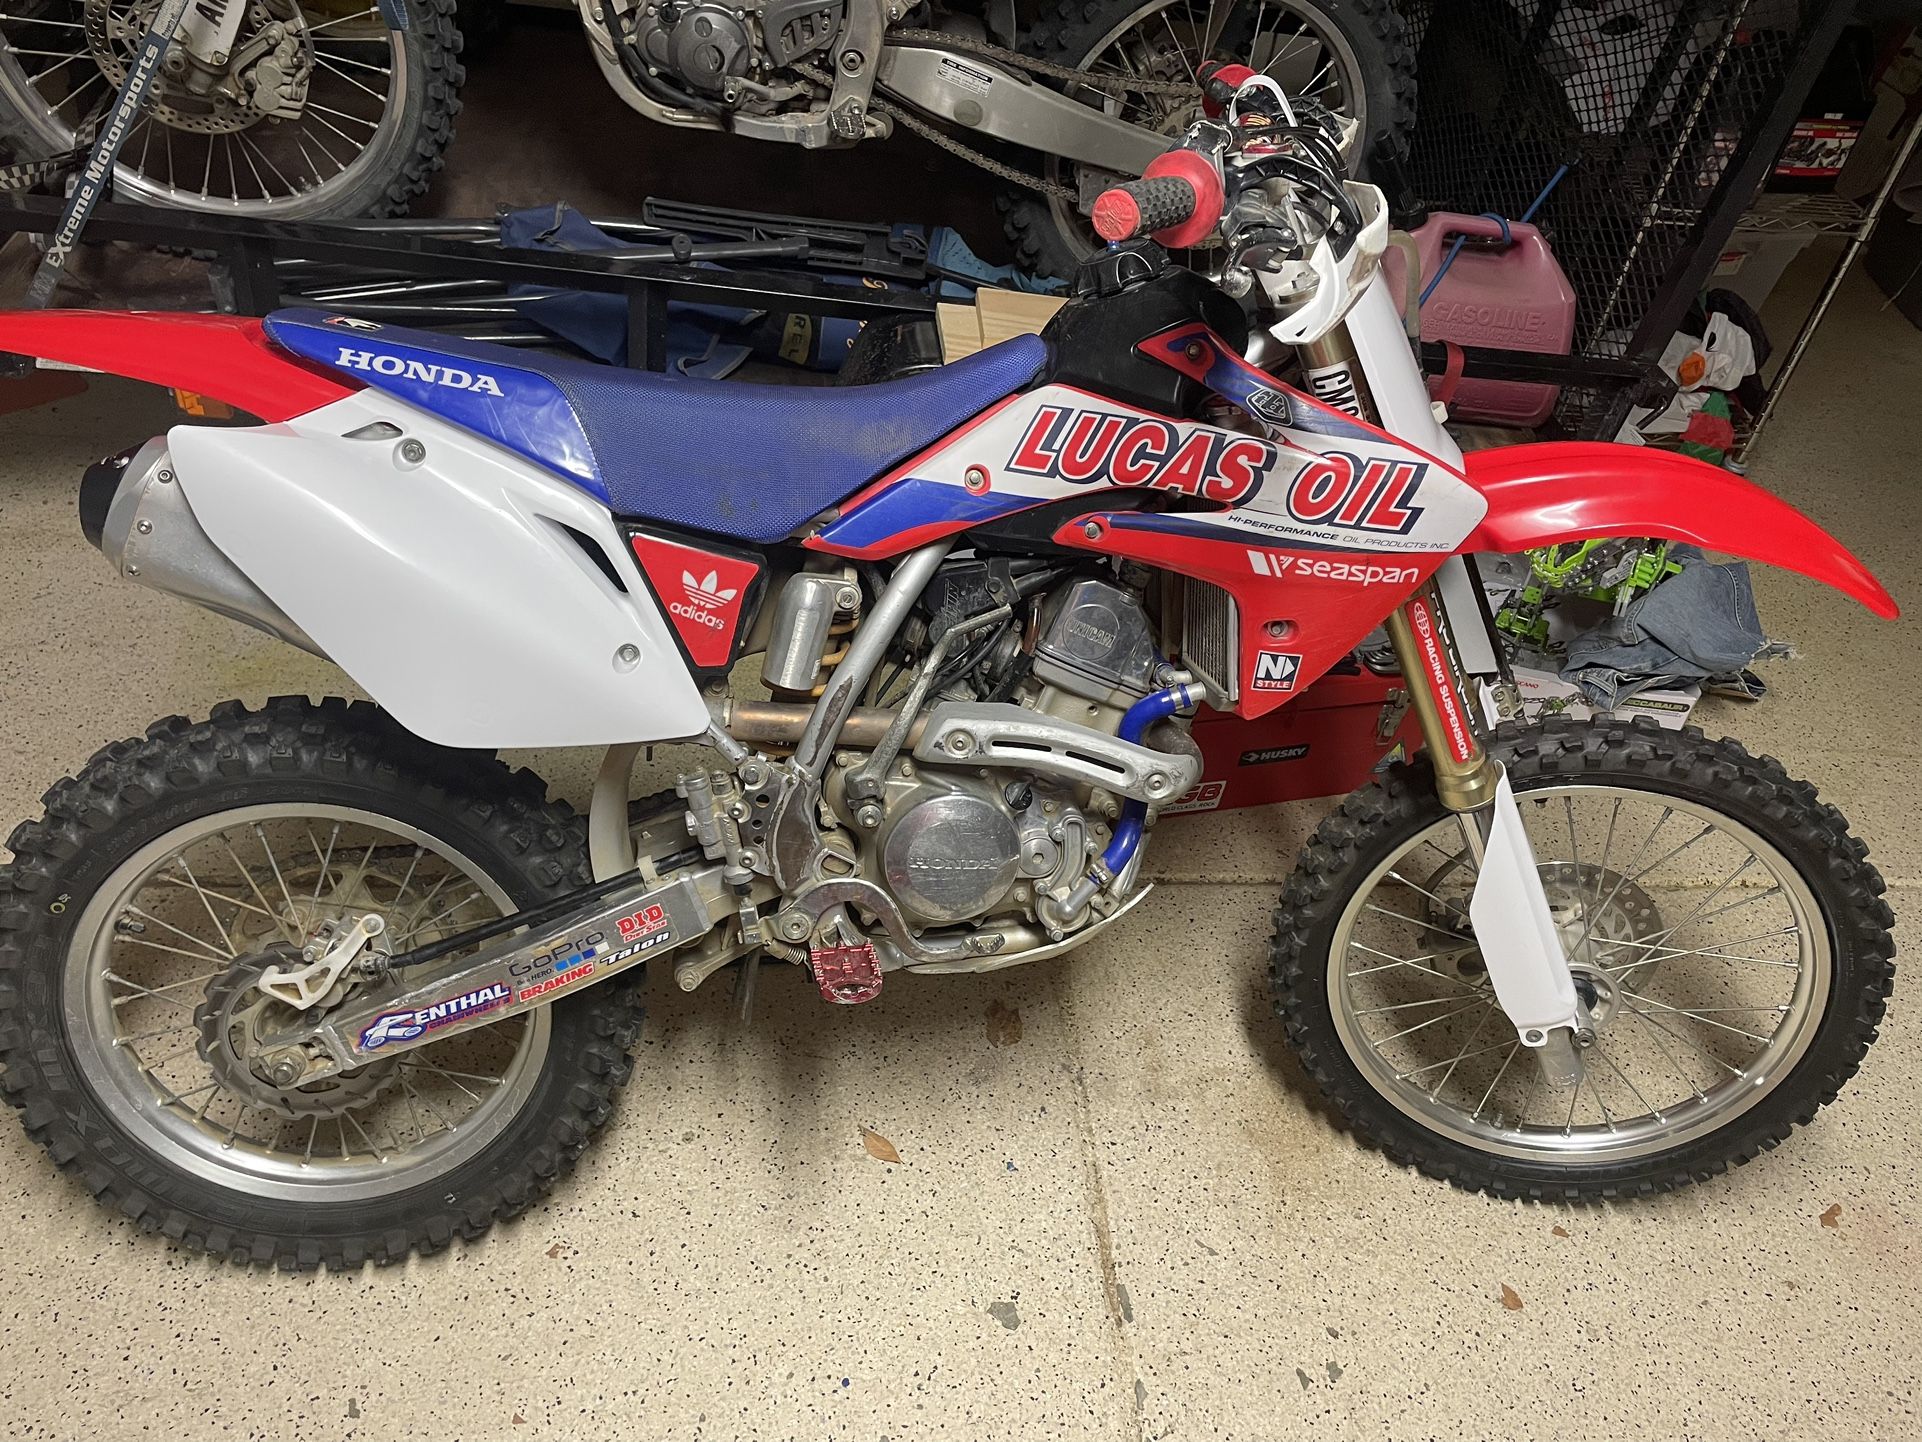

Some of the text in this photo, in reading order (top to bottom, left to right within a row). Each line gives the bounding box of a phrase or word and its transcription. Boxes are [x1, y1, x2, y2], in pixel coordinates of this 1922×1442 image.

[85, 44, 159, 184] Motorsports
[1432, 302, 1542, 332] GASOLINE
[335, 348, 504, 396] HONDA
[1004, 404, 1429, 535] LUCAS OIL
[1228, 515, 1450, 550] HI-PERFORMANCE OIL PRODUCTS INC
[1295, 559, 1419, 586] seaspan
[669, 602, 725, 630] adidas
[1256, 680, 1290, 688] STYLE
[1424, 638, 1445, 684] RACING
[1440, 684, 1469, 760] SUSPENSION
[1260, 747, 1306, 760] HUSKY
[909, 857, 999, 870] HONDA
[508, 931, 605, 977] GoPro
[600, 931, 670, 966] Talon
[519, 962, 594, 1002] BRAKING
[362, 983, 511, 1049] RENTHAL
